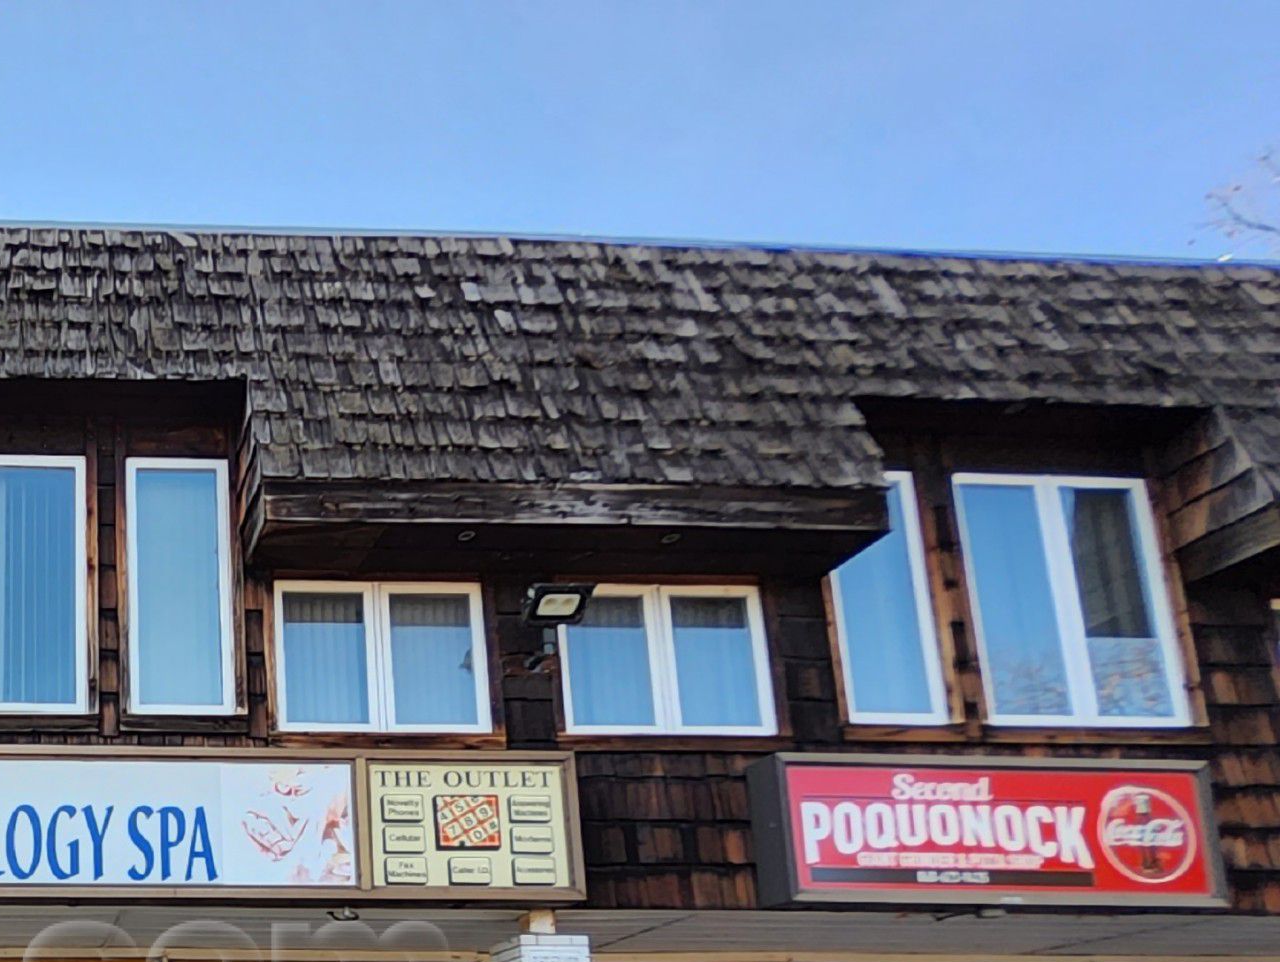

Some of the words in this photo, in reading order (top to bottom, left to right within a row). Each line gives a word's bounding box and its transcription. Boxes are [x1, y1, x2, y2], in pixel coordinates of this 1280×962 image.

[375, 770, 432, 788] THE
[443, 770, 553, 788] OUTLET
[127, 805, 218, 882] SPA
[800, 801, 1096, 869] POQUONOCK
